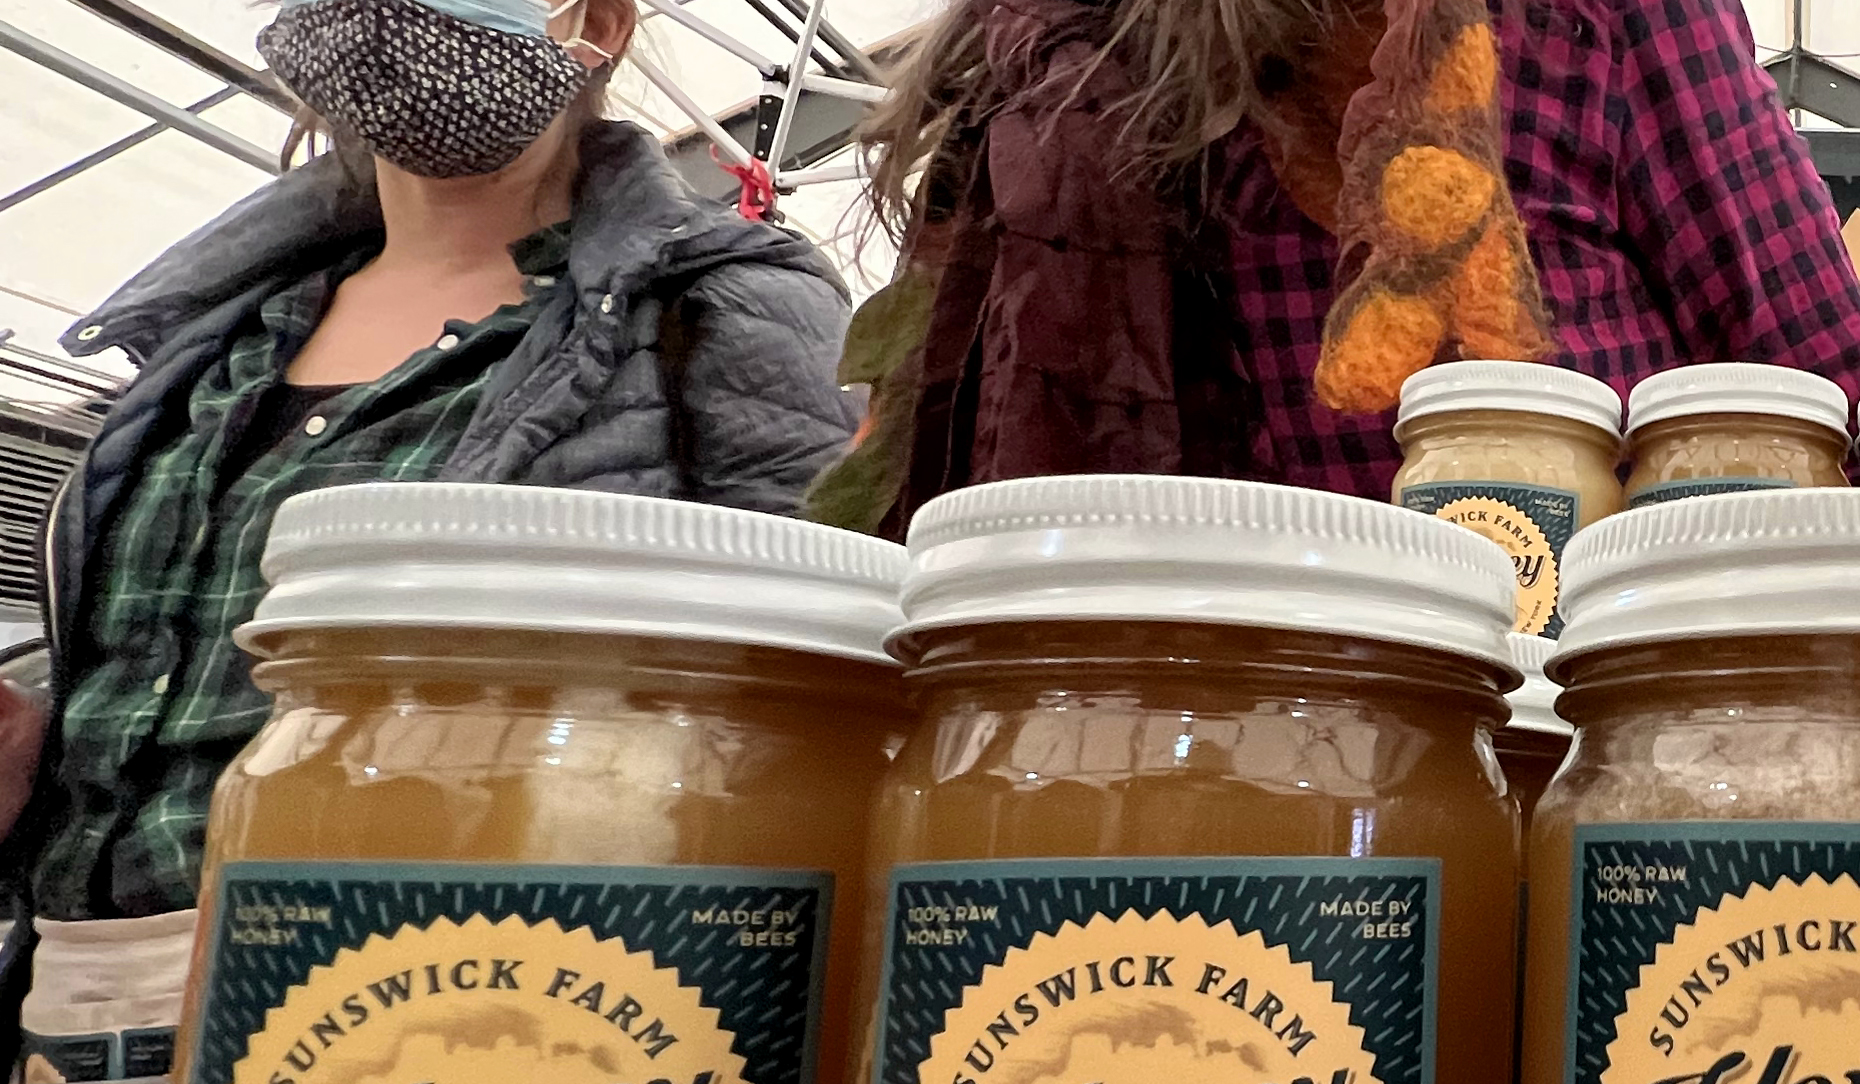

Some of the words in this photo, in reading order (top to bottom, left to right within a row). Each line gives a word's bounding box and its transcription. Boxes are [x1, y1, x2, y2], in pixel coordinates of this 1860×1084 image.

[1494, 515, 1533, 548] FARM
[1597, 865, 1641, 881] 100%
[1645, 865, 1687, 882] RAW
[1596, 888, 1658, 905] HONEY
[692, 909, 765, 925] MADE
[771, 910, 797, 925] BY
[908, 905, 951, 923] 100%
[955, 904, 998, 921] RAW
[1320, 901, 1383, 917] MADE
[1389, 900, 1411, 916] BY
[740, 931, 797, 946] BEES
[905, 928, 968, 945] HONEY
[1364, 922, 1412, 939] BEES
[1649, 919, 1857, 1057] SUNSWICK
[544, 967, 680, 1060] FARM
[1195, 962, 1317, 1057] FARM
